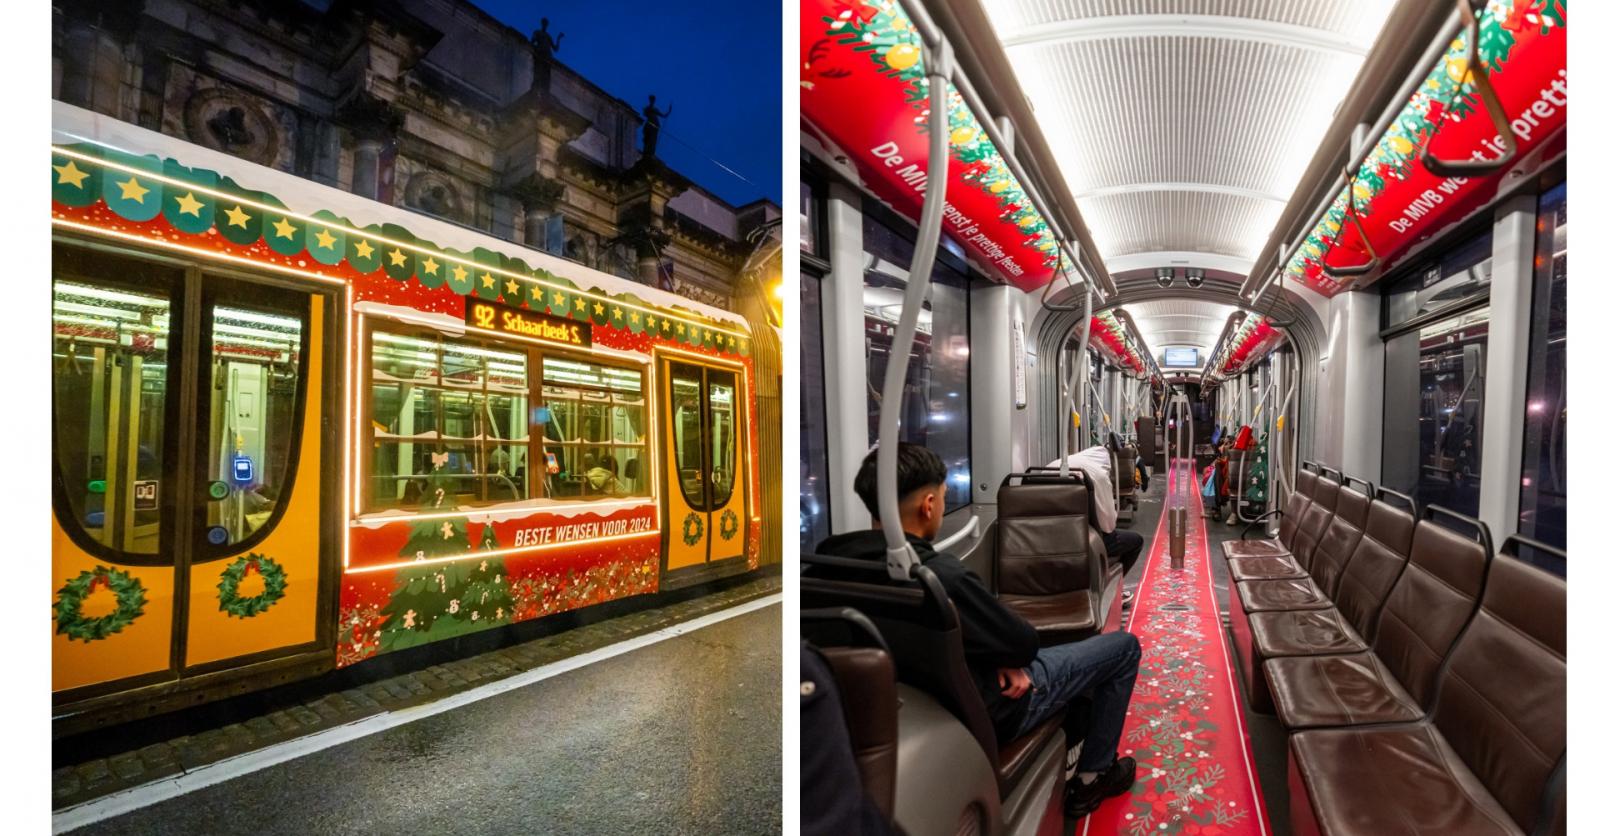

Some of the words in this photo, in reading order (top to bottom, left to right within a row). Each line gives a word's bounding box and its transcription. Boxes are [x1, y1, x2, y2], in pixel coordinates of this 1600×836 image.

[870, 140, 904, 168] De
[896, 163, 928, 198] MIV
[957, 223, 979, 235] je
[968, 233, 1005, 259] prettige
[995, 255, 1024, 276] feesten
[1388, 215, 1413, 234] De
[1403, 189, 1444, 221] MIVB
[1437, 150, 1492, 195] wet
[474, 304, 495, 329] 92
[503, 311, 570, 340] Schaarbeek
[571, 326, 581, 344] S.
[514, 526, 553, 547] BESTE
[555, 521, 600, 542] WENSEN
[601, 518, 627, 535] VOOR
[629, 516, 651, 533] 2024
